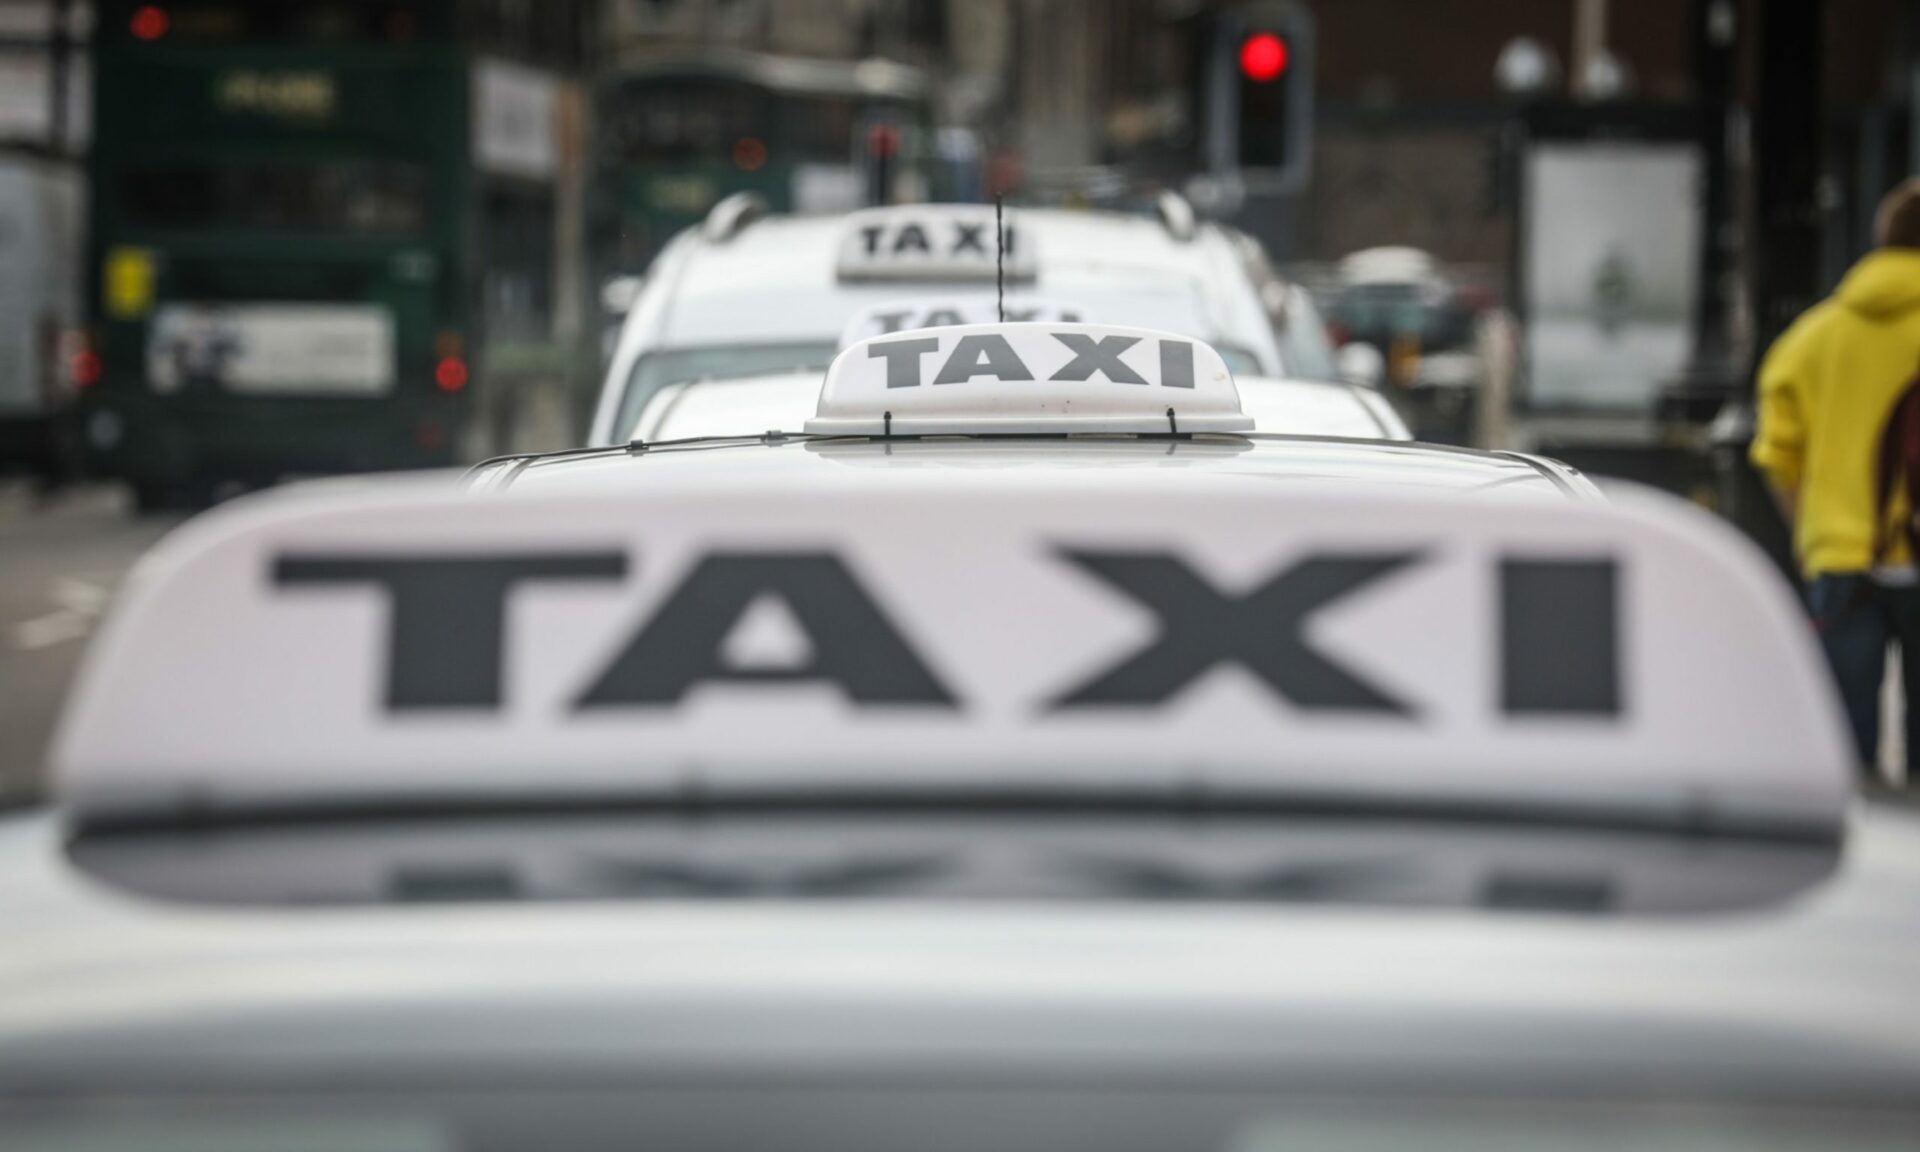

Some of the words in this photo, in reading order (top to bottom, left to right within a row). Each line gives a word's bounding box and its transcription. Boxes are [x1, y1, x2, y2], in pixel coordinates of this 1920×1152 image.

[861, 221, 1015, 256] TAXI
[868, 332, 1195, 390] TAXI
[268, 546, 1627, 720] TAXI
